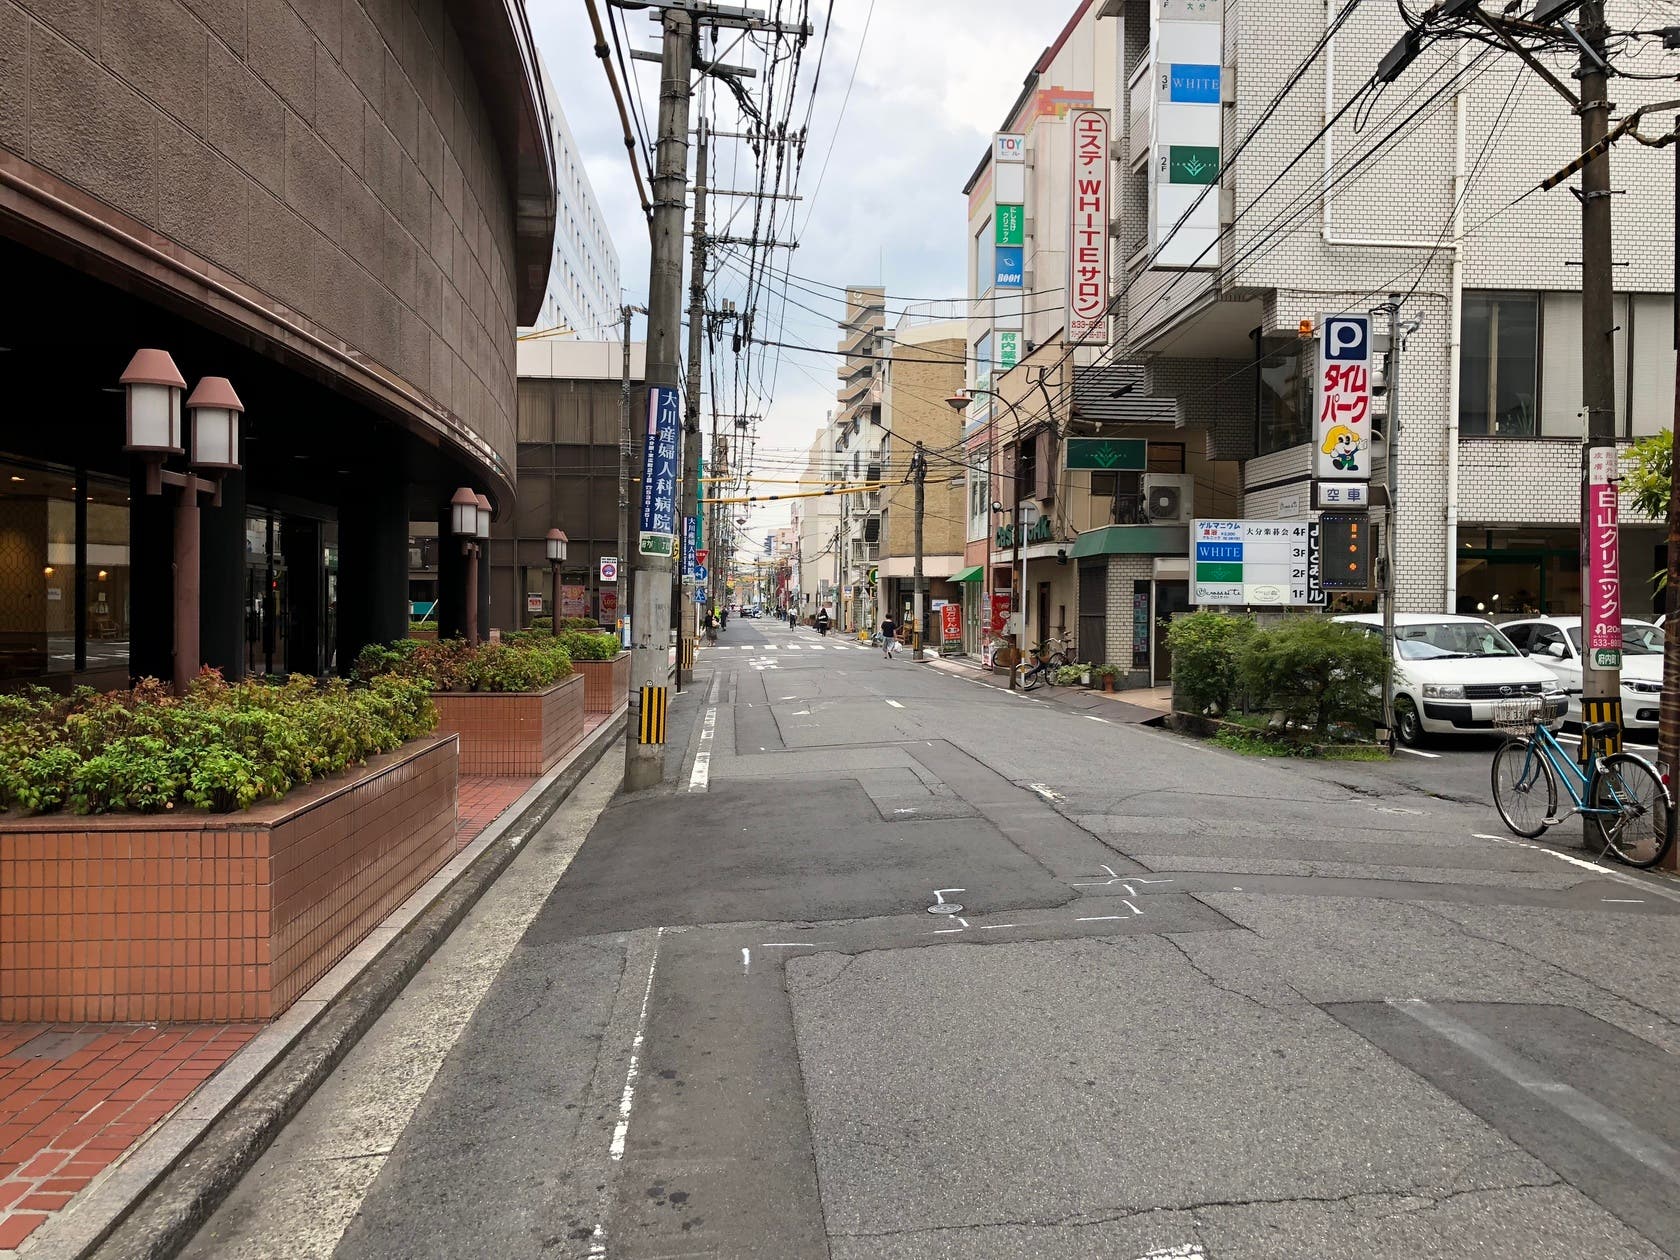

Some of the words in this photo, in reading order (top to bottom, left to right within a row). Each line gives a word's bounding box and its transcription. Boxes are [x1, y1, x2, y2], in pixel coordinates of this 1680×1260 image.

[1161, 75, 1168, 90] 3F
[1172, 78, 1220, 90] WHITE
[998, 138, 1022, 150] TOY
[1161, 157, 1168, 172] 2F
[1077, 118, 1102, 312] エステ・WHITEサロン
[1330, 321, 1363, 357] P
[1323, 364, 1367, 393] タイム
[1321, 393, 1369, 424] パーク
[653, 391, 677, 531] 大川産婦人科病院
[1327, 488, 1361, 502] 空車
[1198, 522, 1241, 530] ゲルマニウム
[1292, 528, 1306, 537] 4F
[1199, 547, 1241, 558] WHITE
[1292, 548, 1306, 557] 3F
[1597, 487, 1618, 619] 白山クリニック
[1292, 569, 1306, 578] 2F
[1292, 590, 1304, 599] 1F
